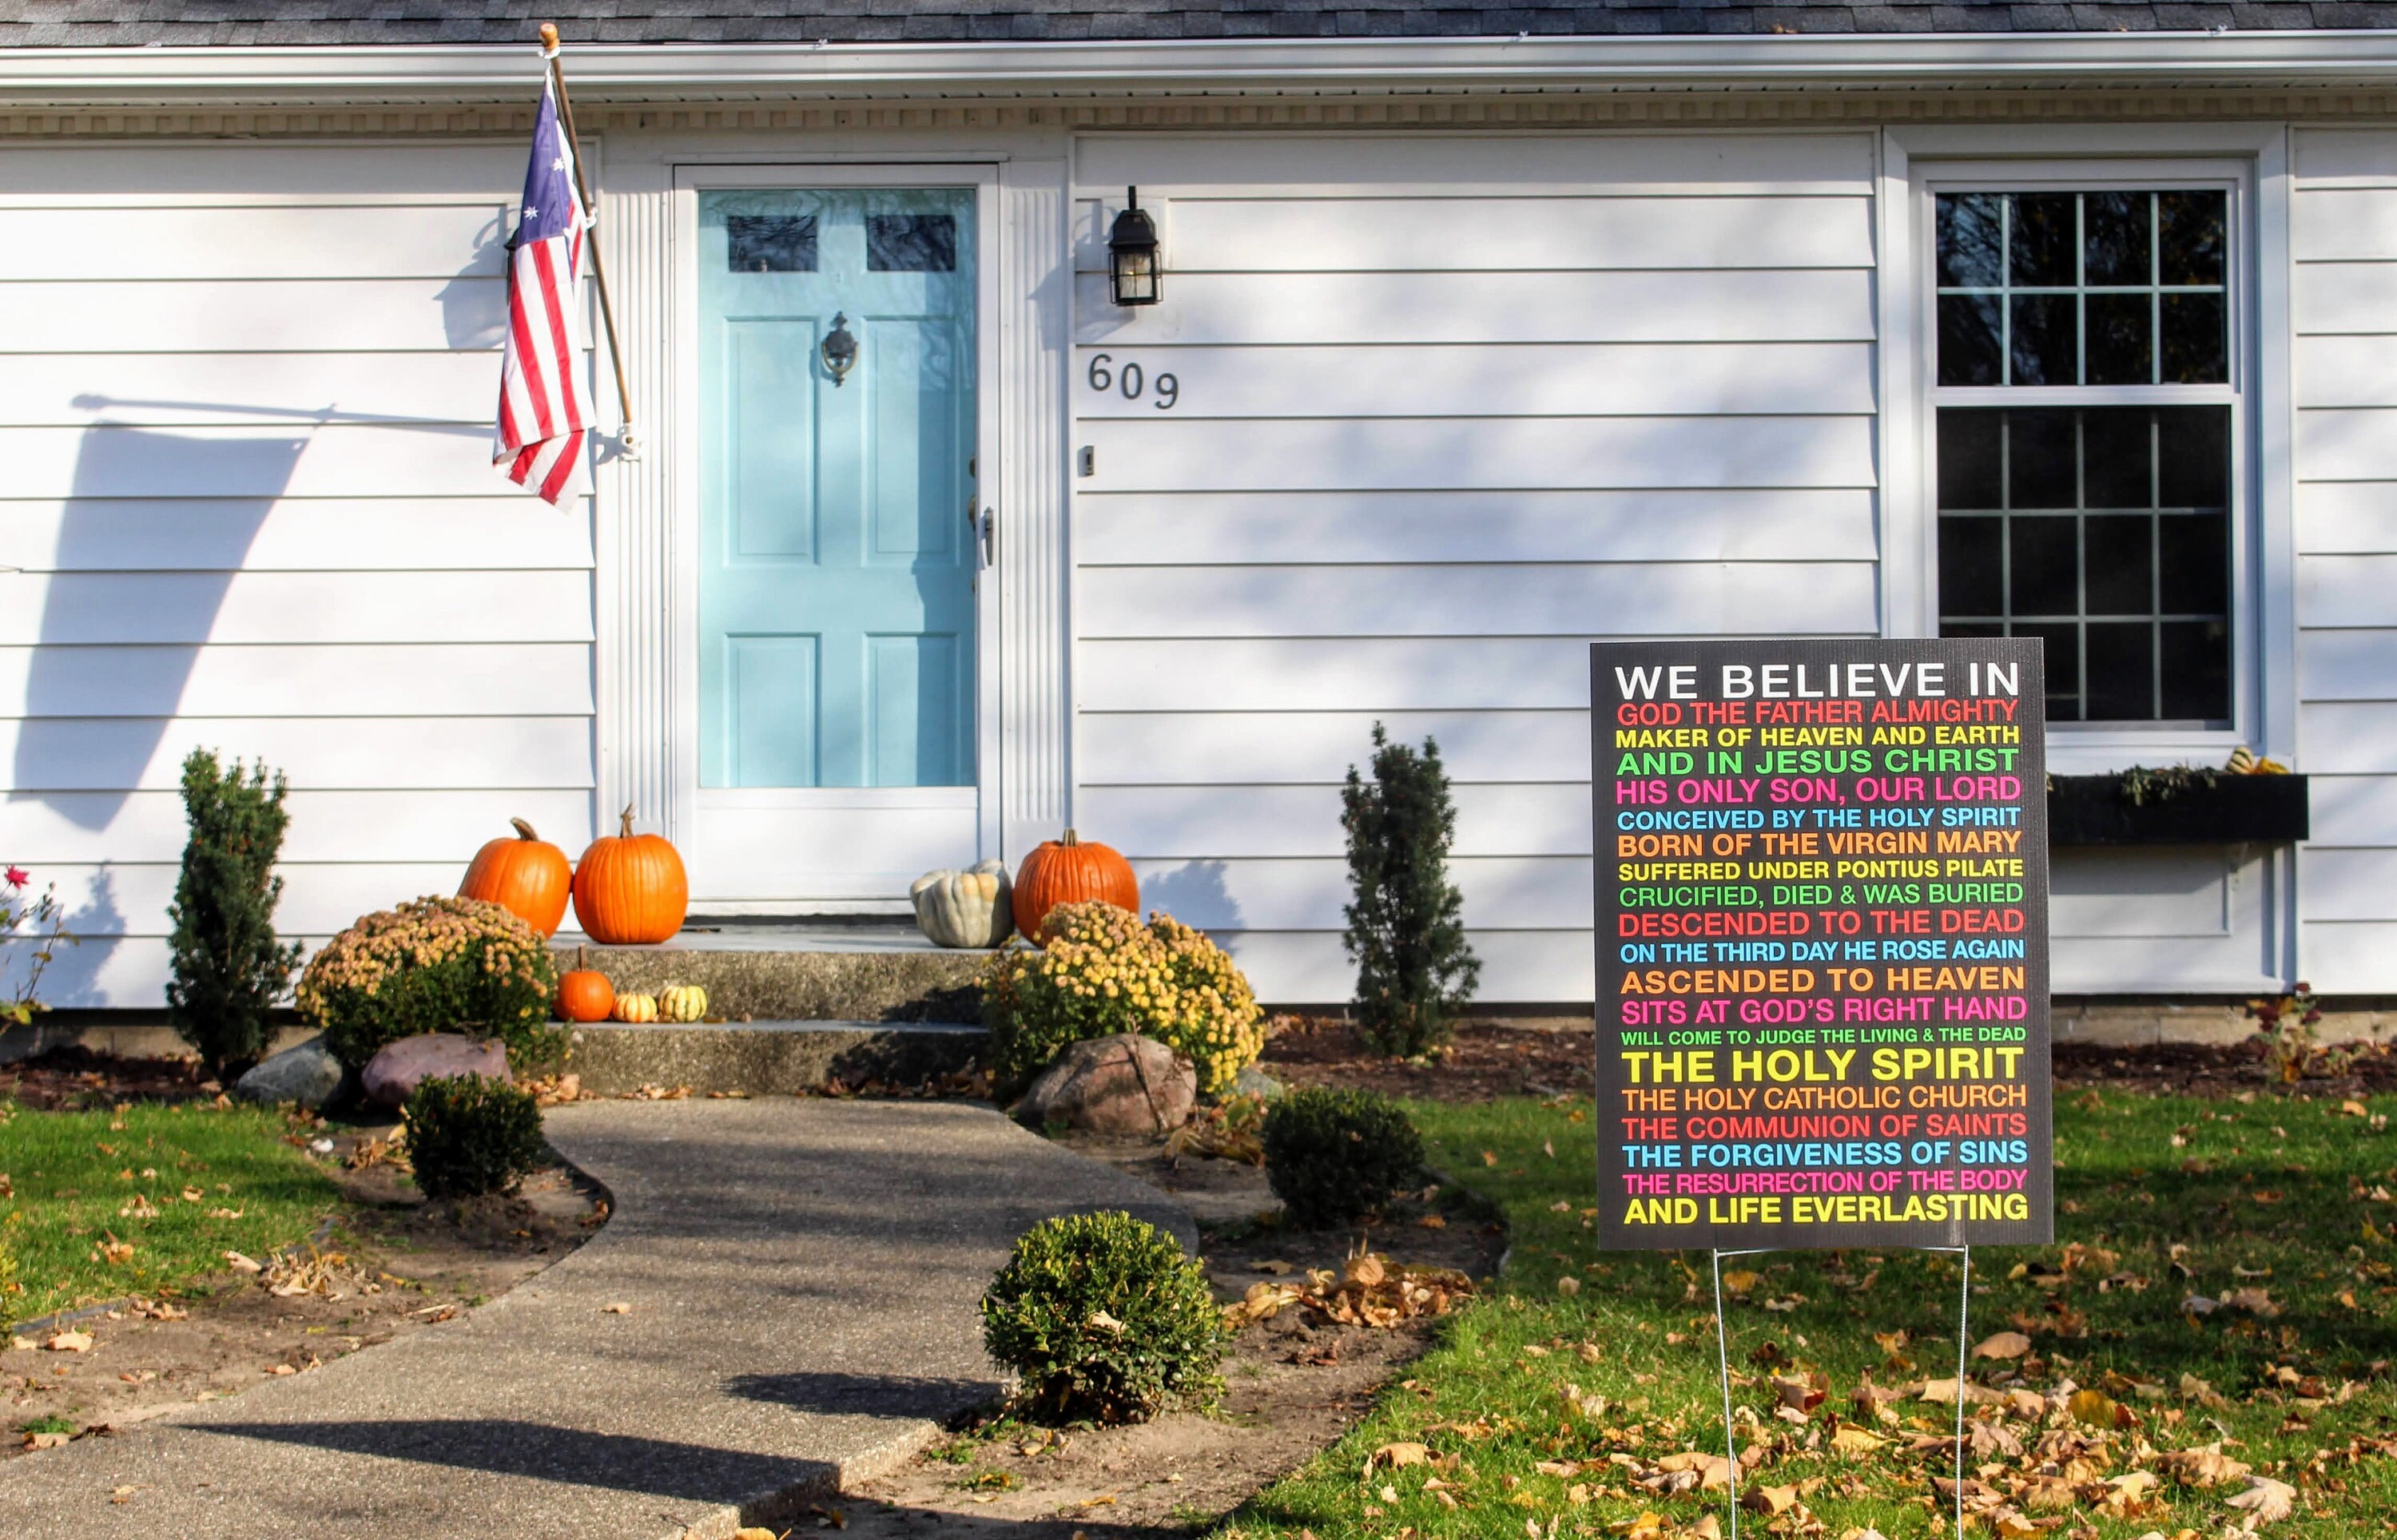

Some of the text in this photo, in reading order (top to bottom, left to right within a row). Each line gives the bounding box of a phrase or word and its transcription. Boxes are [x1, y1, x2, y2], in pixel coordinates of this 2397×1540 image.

[1088, 353, 1179, 410] 609
[1615, 661, 2018, 700] WE BELIEVE IN
[1617, 697, 2018, 727] GOD THE FATHER ALMIGHTY
[1616, 724, 2020, 749] MAKER OF HEAVEN AND EARTH
[1616, 747, 2019, 776] AND IN JESUS CHRIST
[1616, 773, 2023, 806] HIS ONLY SON, OUR LORD
[1617, 806, 2021, 832] CONCEIVED BY THE HOLY SPIRIT
[1618, 828, 2022, 859] BORN OF THE VIRGIN MARY
[1618, 856, 2024, 882] SUFFERED UNDER PONTIUS PILATE
[1620, 882, 2024, 907] CRUCIFIED, DIED & WAS BURIED
[1619, 907, 2026, 938] DESCENDED TO THE DEAD
[1620, 938, 2025, 964] ON THE THIRD DAY HE ROSE AGAIN
[1620, 965, 2025, 995] ASCENDED TO HEAVEN
[1621, 994, 2029, 1026] SITS AT GOD'S RIGHT HAND
[1620, 1026, 2026, 1046] WILL COME TO JUDGE THE LIVING & THE DEAD
[1621, 1046, 2025, 1084] THE HOLY SPIRIT
[1621, 1083, 2027, 1113] THE HOLY CATHOLIC CHURCH
[1620, 1110, 2028, 1141] THE COMMUNION OF SAINTS
[1621, 1139, 2028, 1169] THE FORGIVENESS OF SINS
[1621, 1168, 2029, 1196] THE RESURRECTION OF THE BODY
[1624, 1192, 2029, 1225] AND LIFE EVERLASTING
